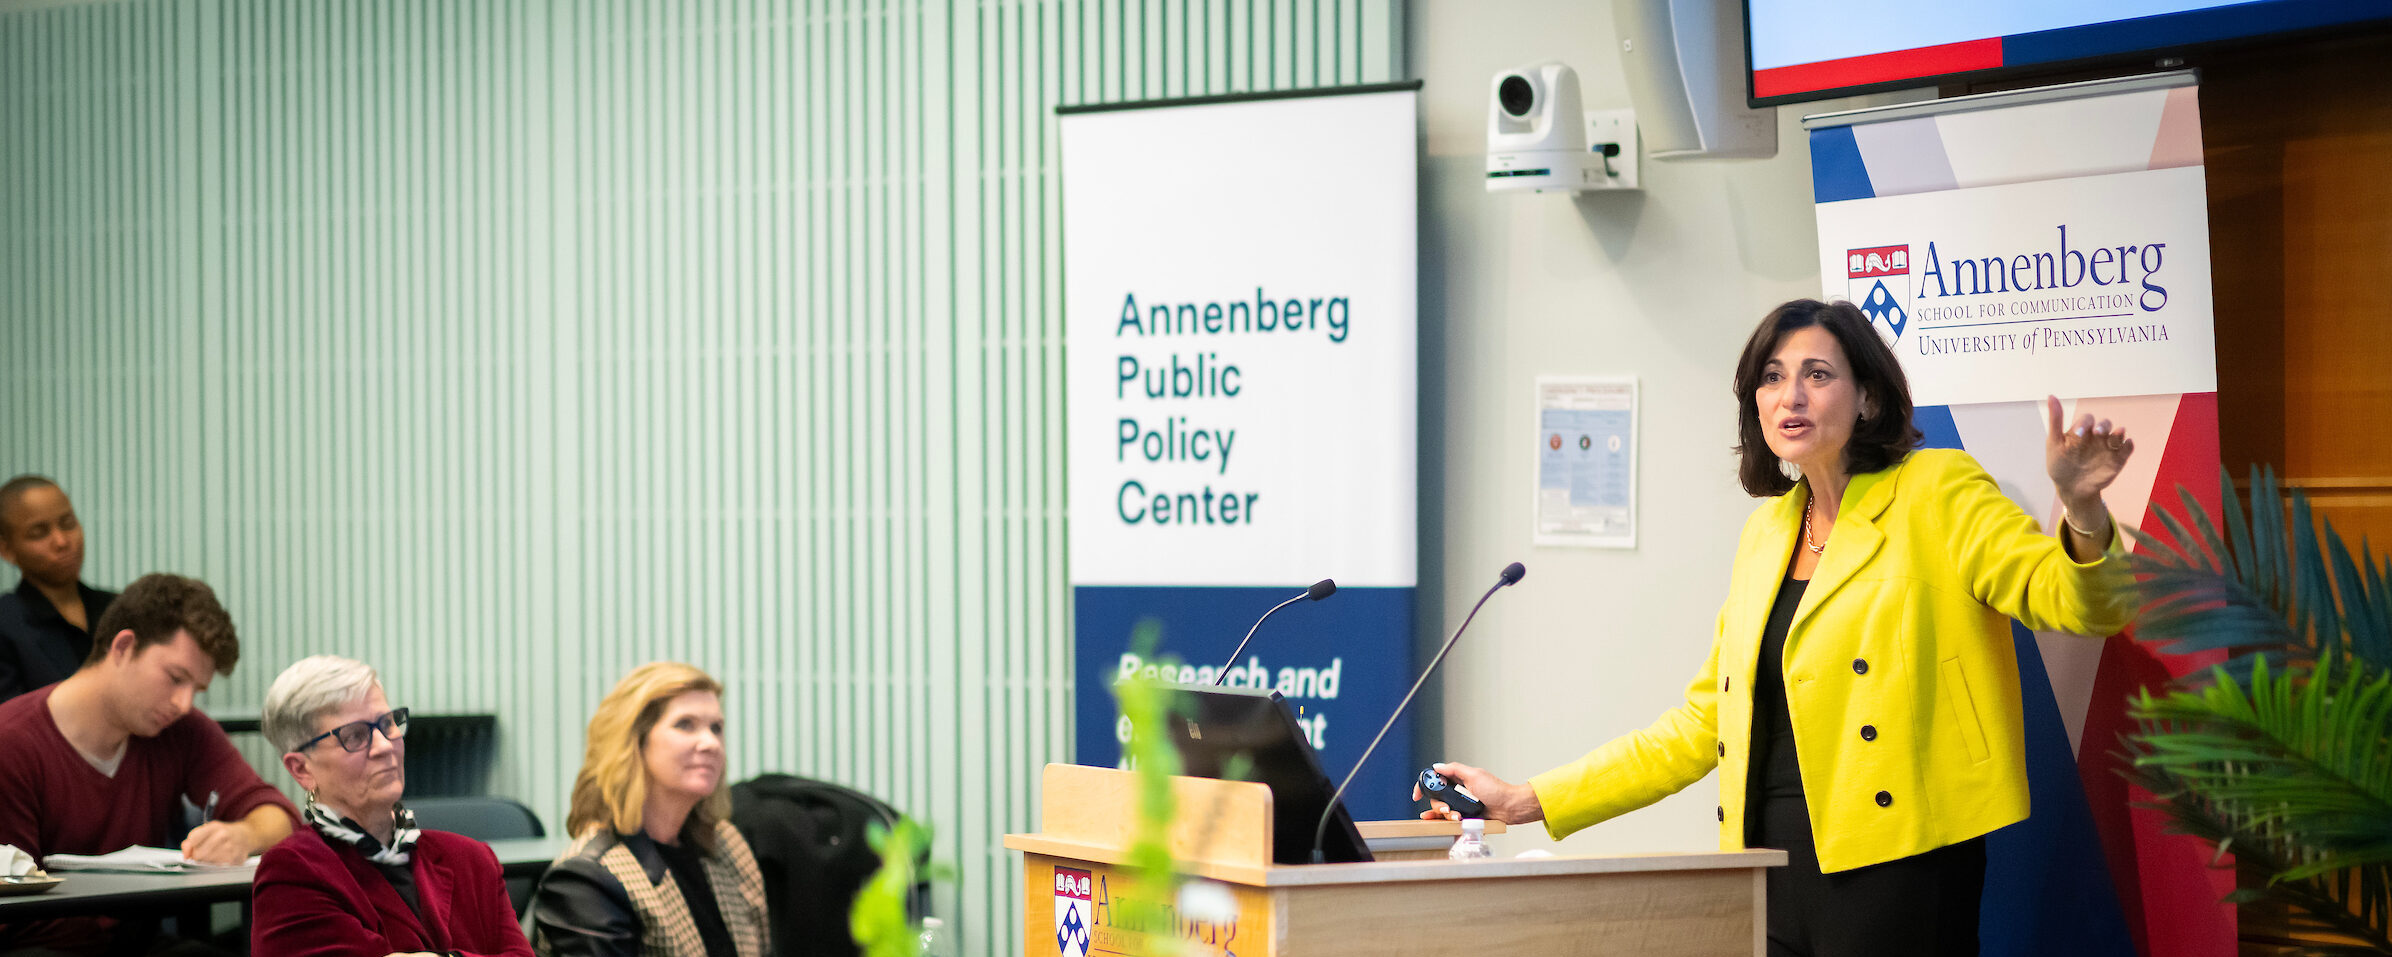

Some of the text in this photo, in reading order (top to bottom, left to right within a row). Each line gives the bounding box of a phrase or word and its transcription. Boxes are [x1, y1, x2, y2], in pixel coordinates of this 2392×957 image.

[1918, 224, 2168, 312] Annenberg
[1116, 286, 1350, 344] Annenberg
[1917, 293, 2134, 322] SCHOOL FOR COMMUNICATION
[1918, 324, 2169, 356] UNIVERSITY of PENNSYLVANIA
[1117, 352, 1241, 400] Public
[1117, 416, 1236, 475] Policy
[1117, 479, 1260, 526] Center
[1274, 658, 1342, 699] and
